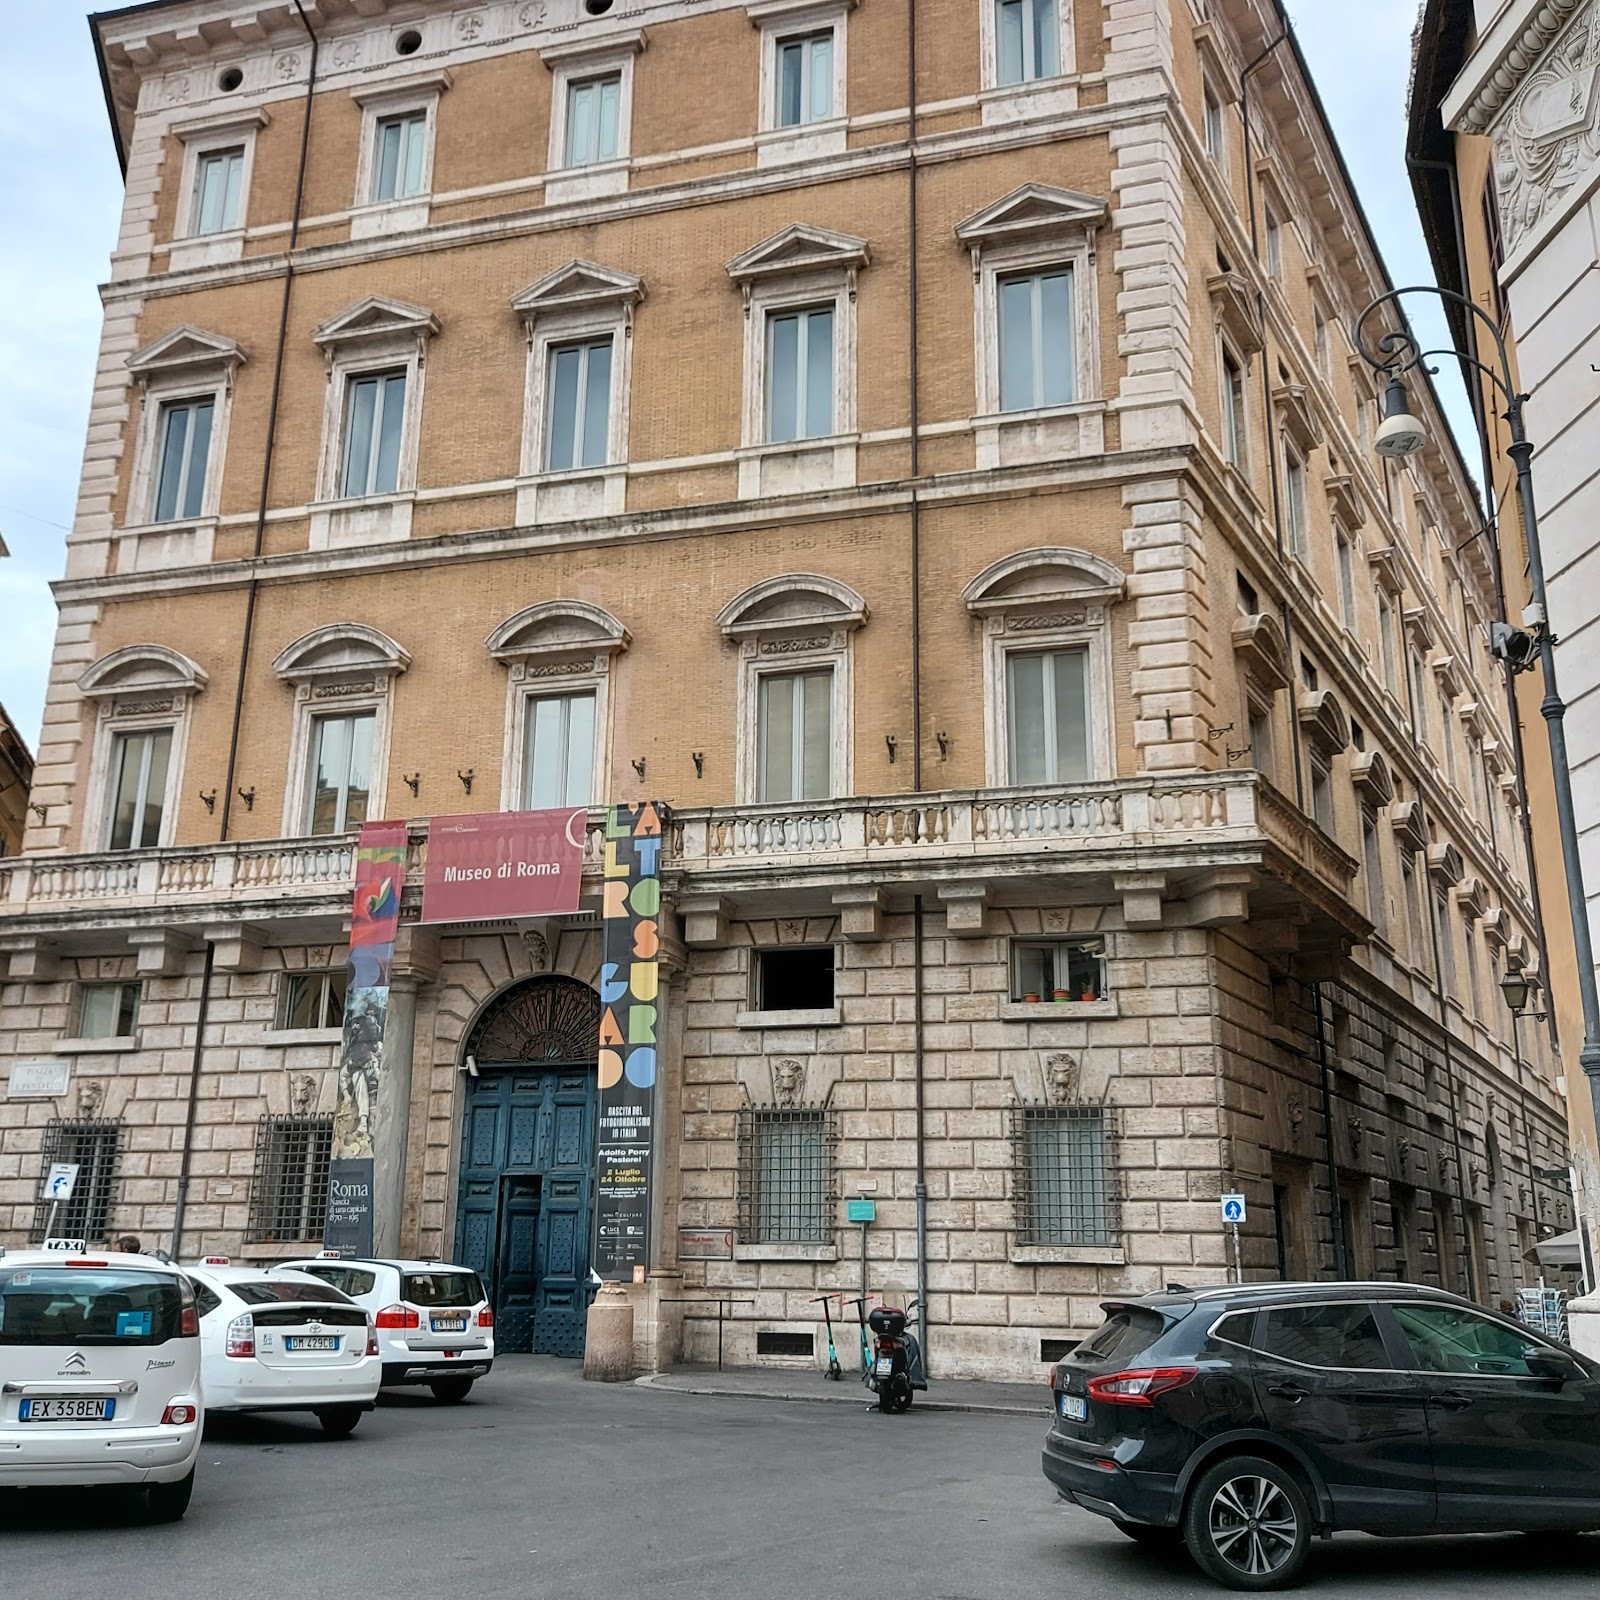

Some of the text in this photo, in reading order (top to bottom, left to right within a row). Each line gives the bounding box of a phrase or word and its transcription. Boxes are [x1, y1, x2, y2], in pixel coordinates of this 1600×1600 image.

[444, 861, 560, 882] Museo di Roma
[608, 1106, 643, 1116] NASCITA DEL
[600, 1117, 651, 1127] FOTOGIORNALISMO
[612, 1128, 637, 1138] IN ITALIA
[628, 1149, 650, 1157] Porry
[615, 1168, 640, 1176] Luglio
[330, 1180, 368, 1197] Roma
[347, 1204, 368, 1215] capitale
[50, 1241, 83, 1250] TAXI
[143, 1312, 149, 1322] E
[31, 1400, 105, 1417] EX 358EN
